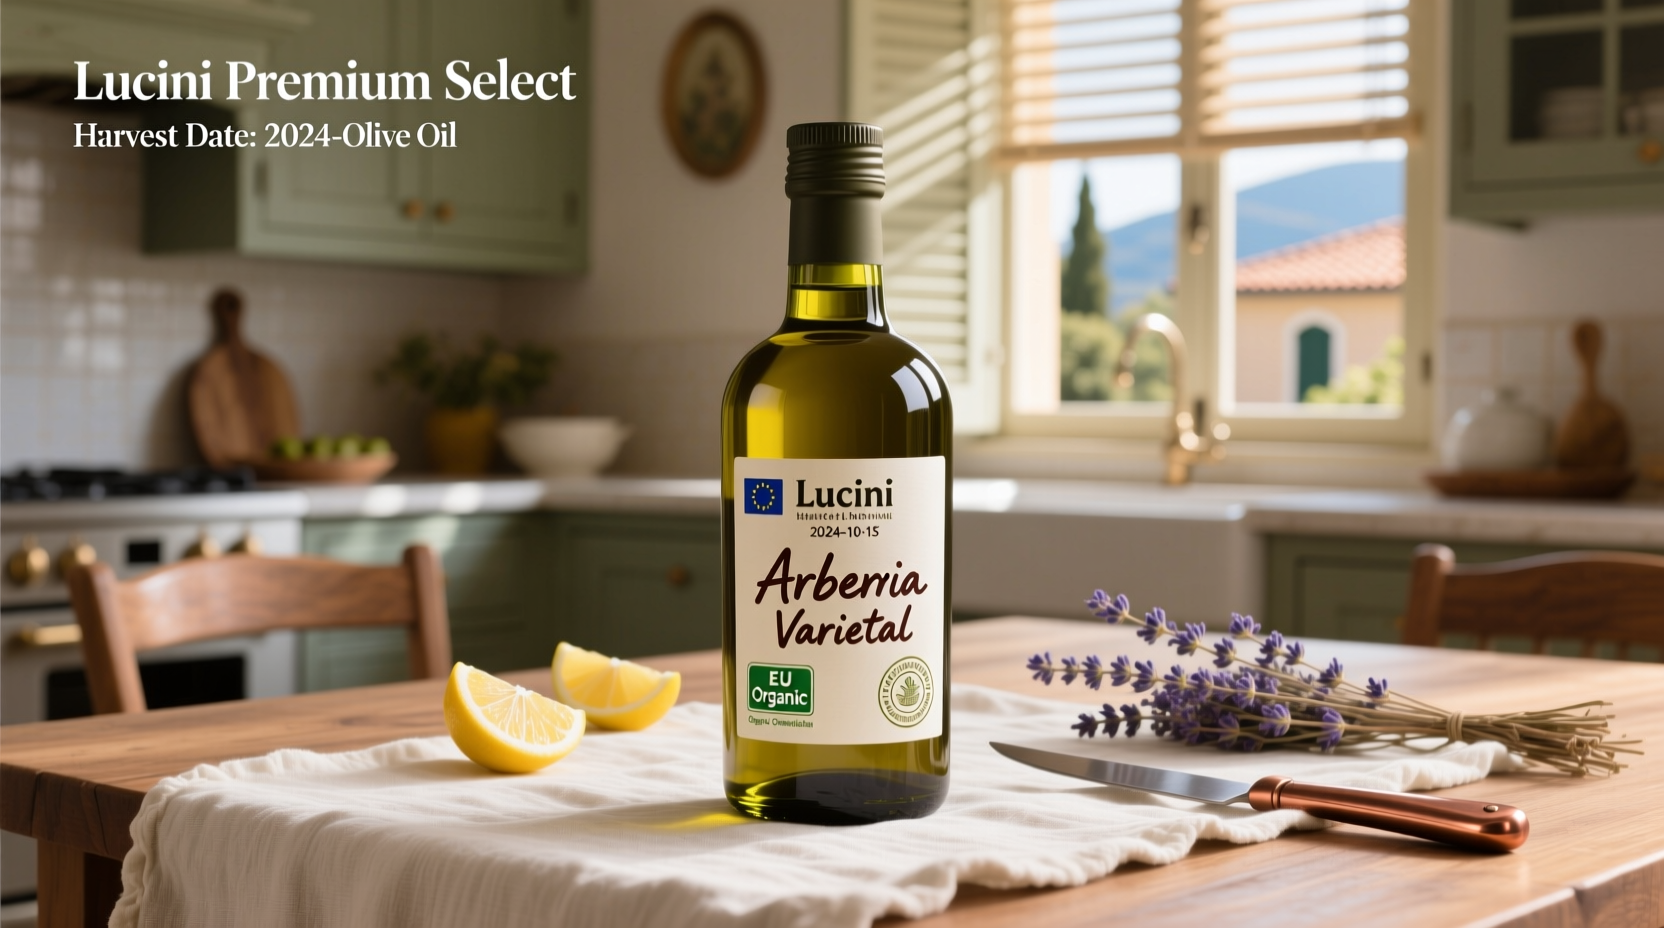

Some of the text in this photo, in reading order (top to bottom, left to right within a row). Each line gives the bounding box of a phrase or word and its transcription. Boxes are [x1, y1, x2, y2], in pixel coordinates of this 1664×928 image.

[796, 478, 893, 508] Lucini
[776, 604, 913, 649] Varietal
[768, 670, 792, 687] EU
[751, 686, 808, 708] Organic
